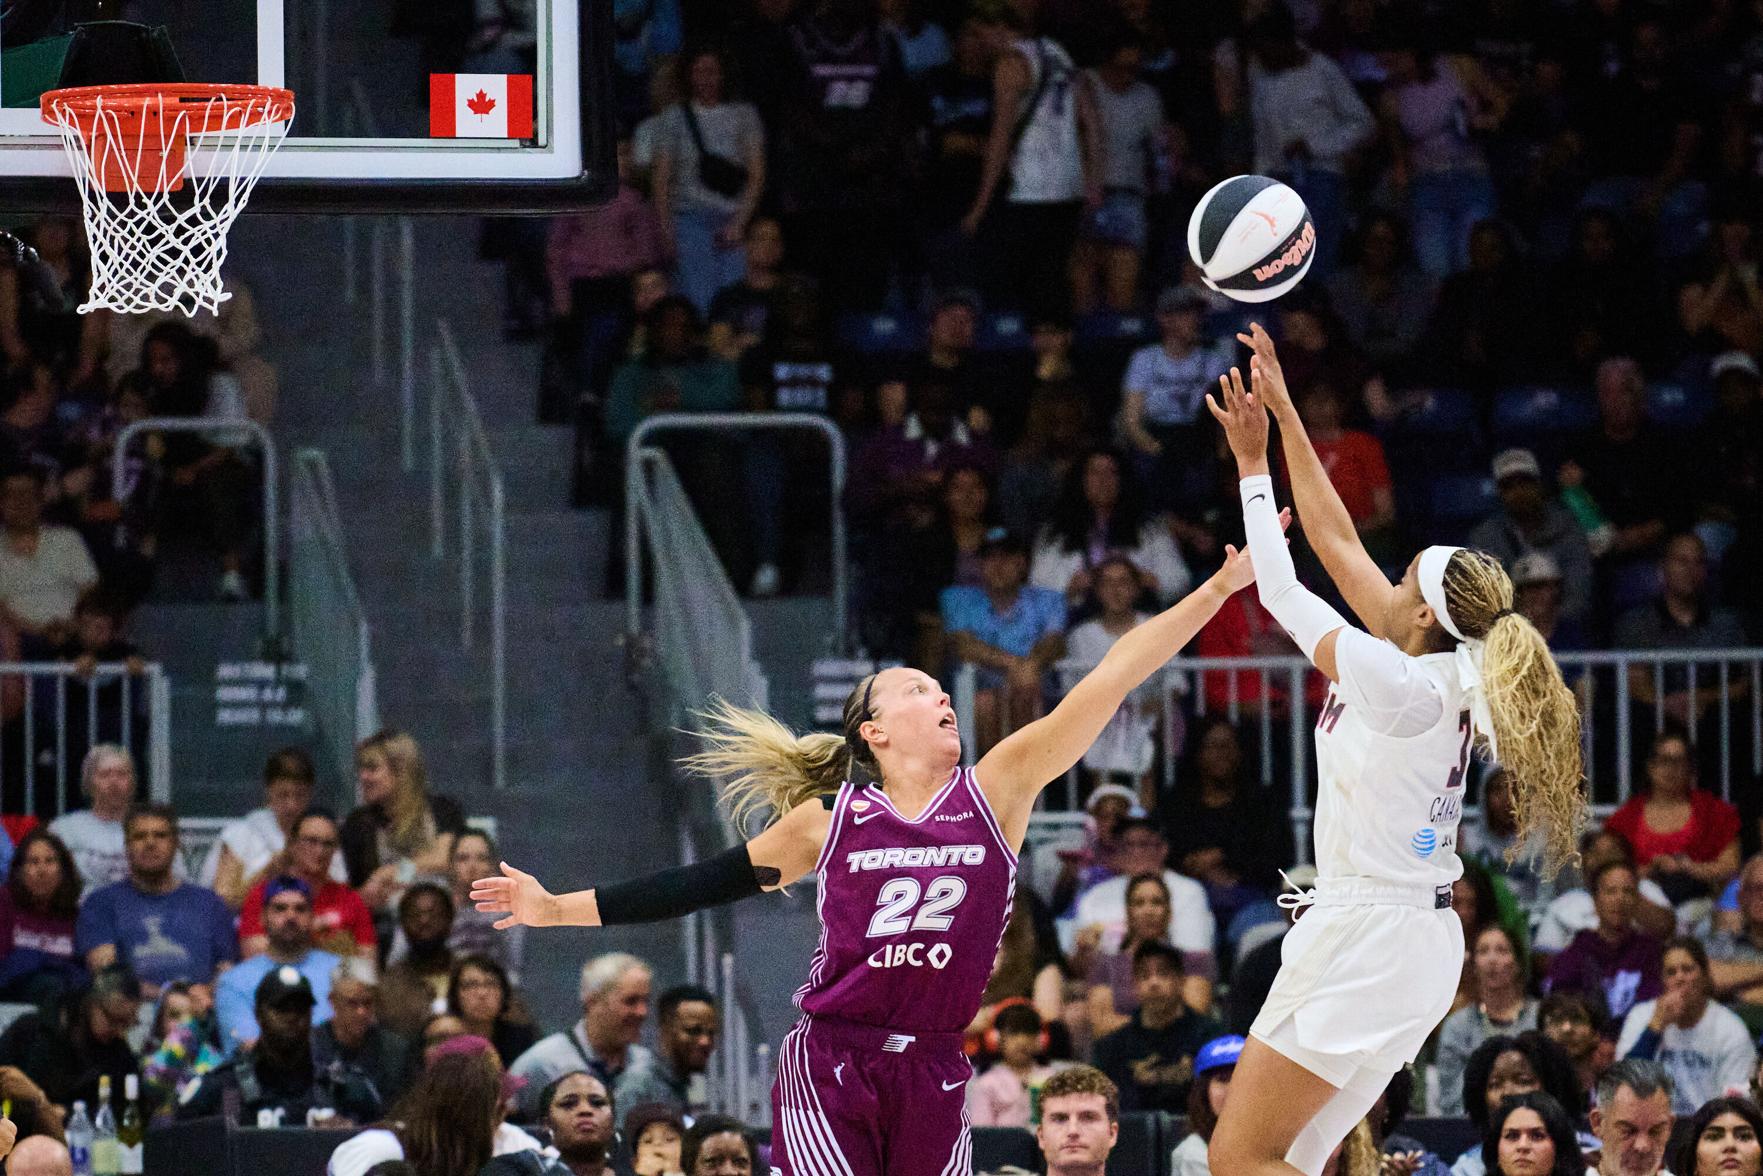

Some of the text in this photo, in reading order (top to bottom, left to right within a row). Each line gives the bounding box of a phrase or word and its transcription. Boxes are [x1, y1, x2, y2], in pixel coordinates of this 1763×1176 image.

[1253, 223, 1315, 281] Wilson
[1318, 692, 1346, 734] M
[935, 811, 974, 822] SEPHORA
[846, 845, 986, 873] TORONTO
[866, 875, 967, 938] 22
[868, 943, 925, 968] CIBC
